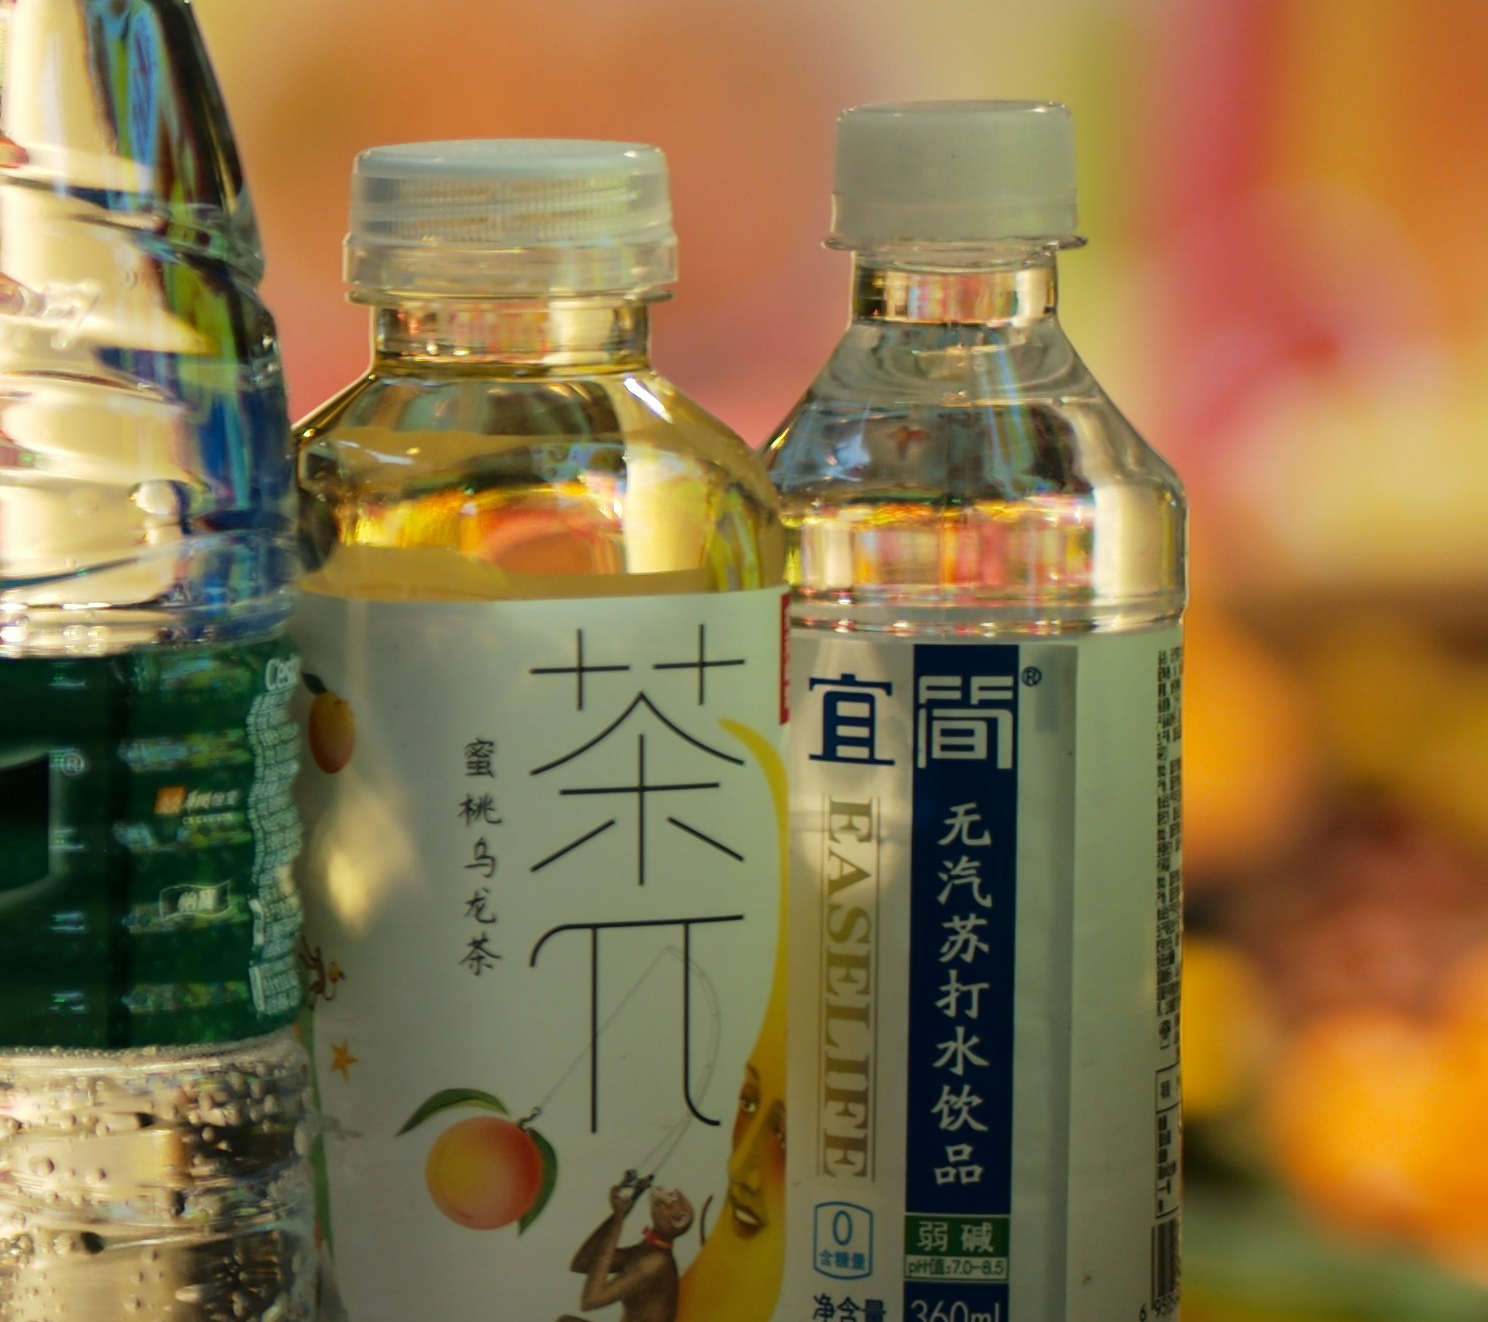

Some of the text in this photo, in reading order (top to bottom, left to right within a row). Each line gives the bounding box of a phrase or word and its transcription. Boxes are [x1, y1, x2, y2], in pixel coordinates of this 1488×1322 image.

[457, 737, 503, 977] 蜜桃乌龙茶
[823, 797, 873, 1178] EASELIFE
[930, 801, 993, 1186] 无汽苏打水饮品
